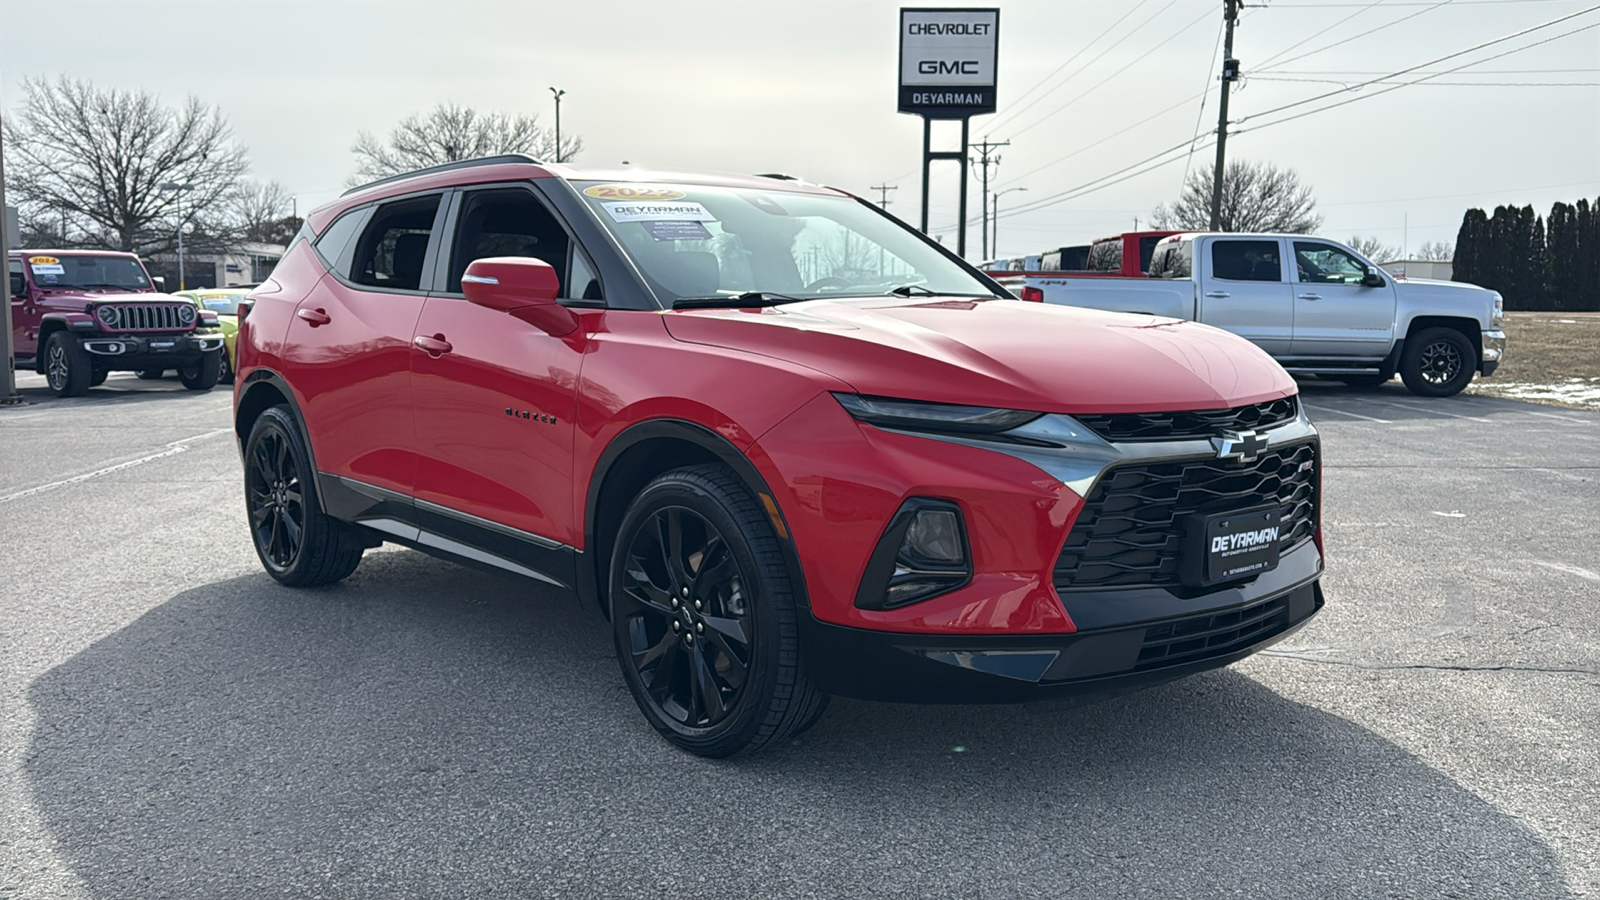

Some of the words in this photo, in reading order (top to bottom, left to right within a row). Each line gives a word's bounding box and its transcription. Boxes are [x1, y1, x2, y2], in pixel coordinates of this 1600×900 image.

[908, 23, 991, 35] CHEVROLET
[918, 60, 979, 75] GMC
[912, 93, 983, 104] DEYARMAN
[598, 187, 675, 197] 2022
[614, 206, 701, 214] DEYARMAN
[505, 407, 557, 425] BLAZER
[1211, 526, 1279, 553] DEYARMAN
